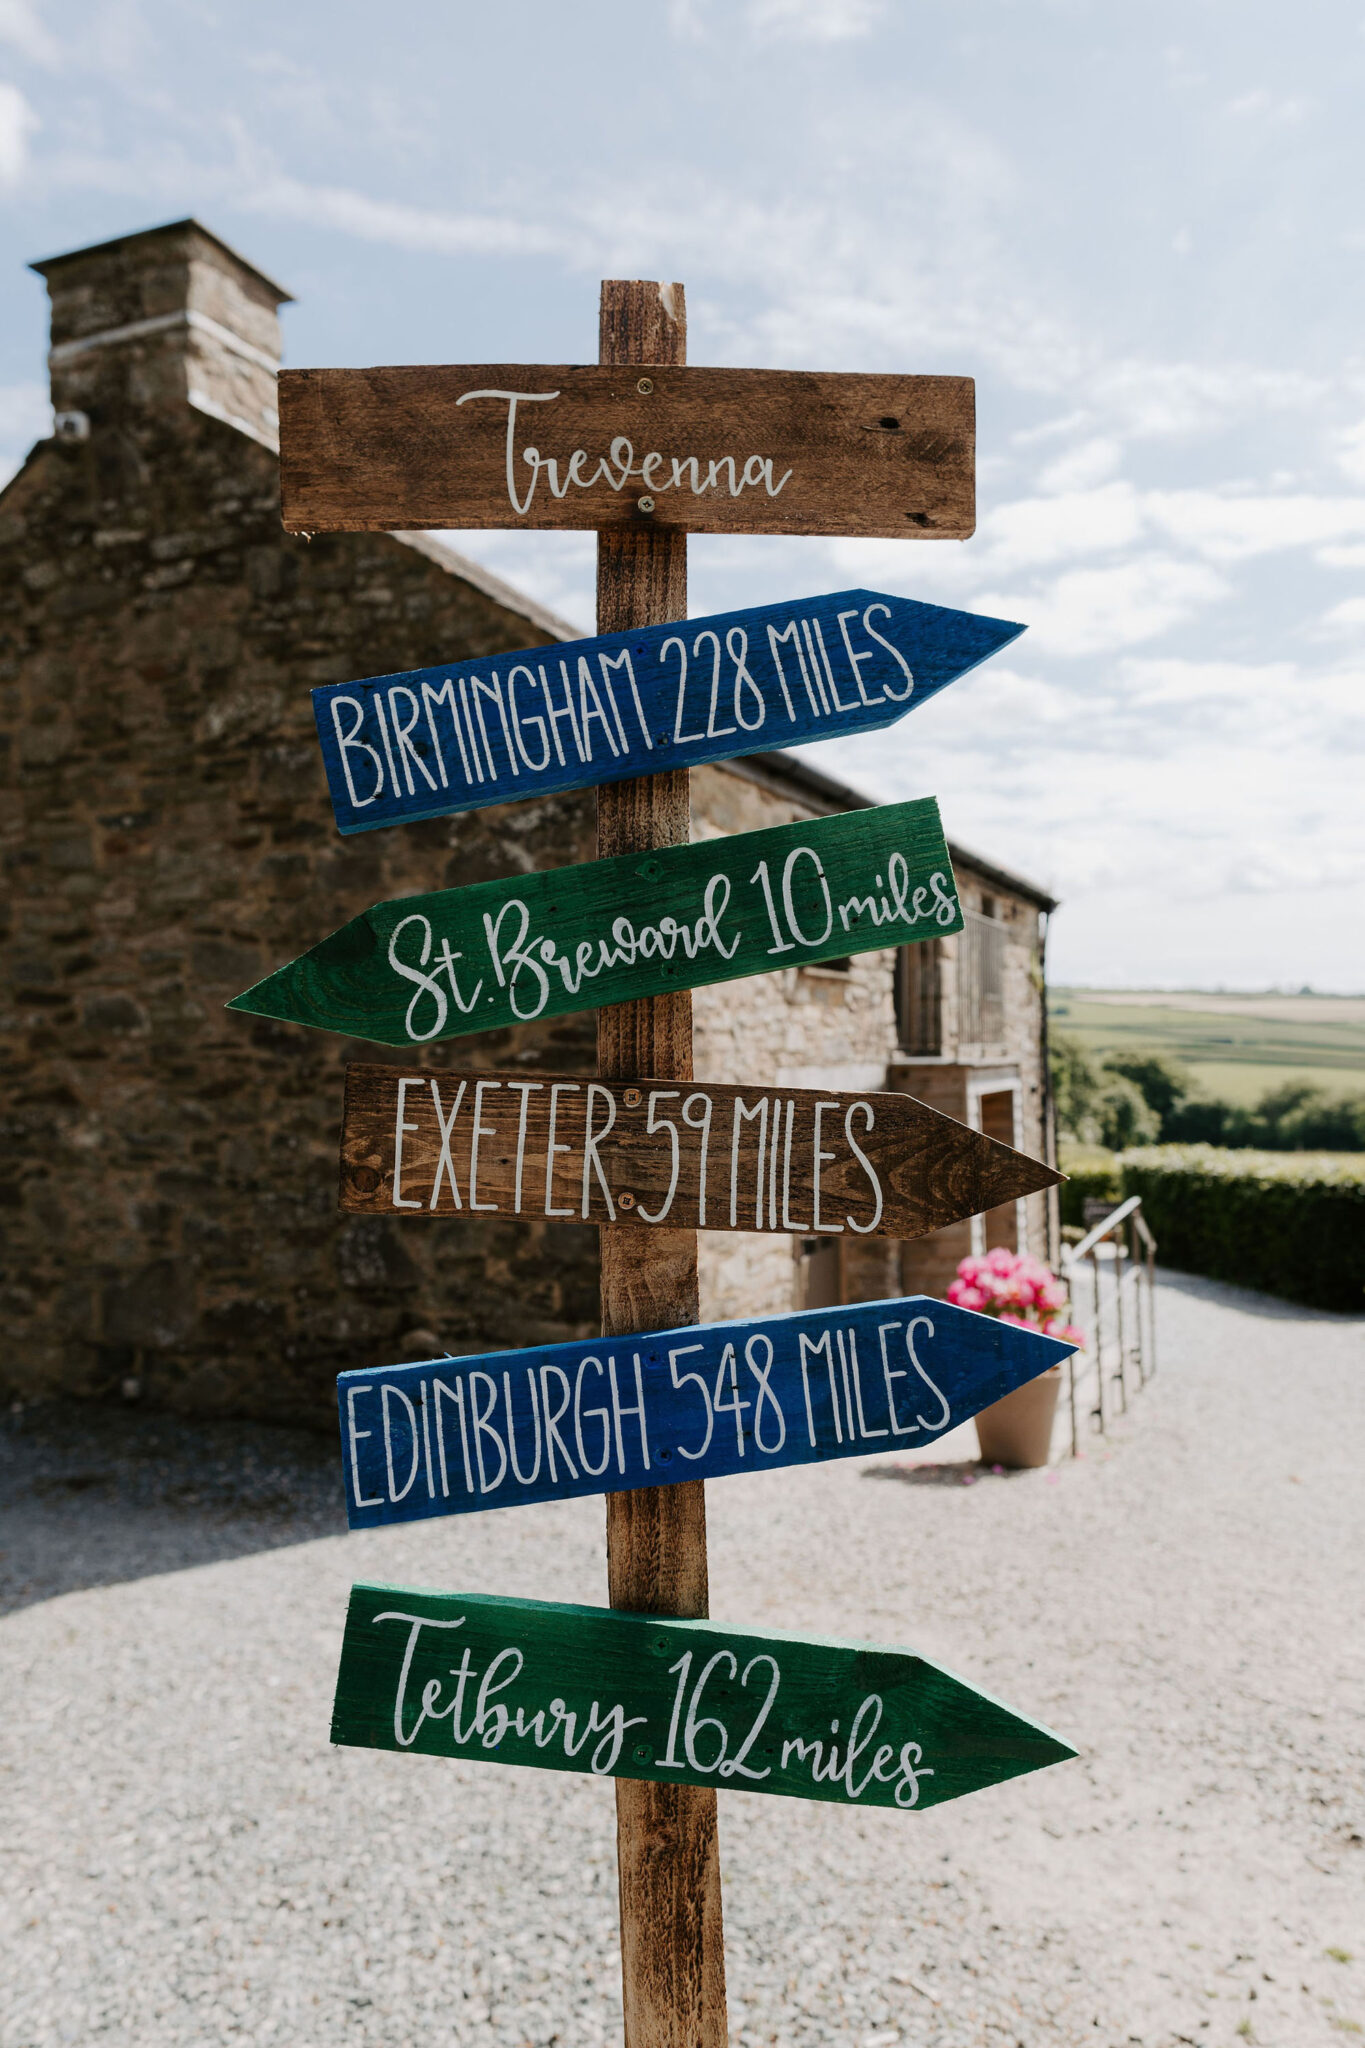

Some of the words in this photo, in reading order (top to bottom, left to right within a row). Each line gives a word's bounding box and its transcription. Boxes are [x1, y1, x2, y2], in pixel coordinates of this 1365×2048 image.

[456, 389, 793, 514] Trevenna
[330, 648, 654, 808] BIRMINGHAM
[659, 626, 765, 744] 228
[766, 602, 915, 724] MILES
[387, 914, 494, 1042] St.
[483, 873, 742, 1021] Breward
[751, 847, 829, 954] 10
[838, 852, 957, 932] miles
[392, 1077, 618, 1222] EXETER
[638, 1090, 712, 1226] 59
[731, 1096, 884, 1233] MILES
[347, 1352, 651, 1507] EDINBURGH
[669, 1334, 786, 1459] 548
[799, 1316, 951, 1447] MILES
[372, 1612, 647, 1775] Tetbury
[655, 1650, 781, 1777] 162
[781, 1694, 934, 1808] miles
